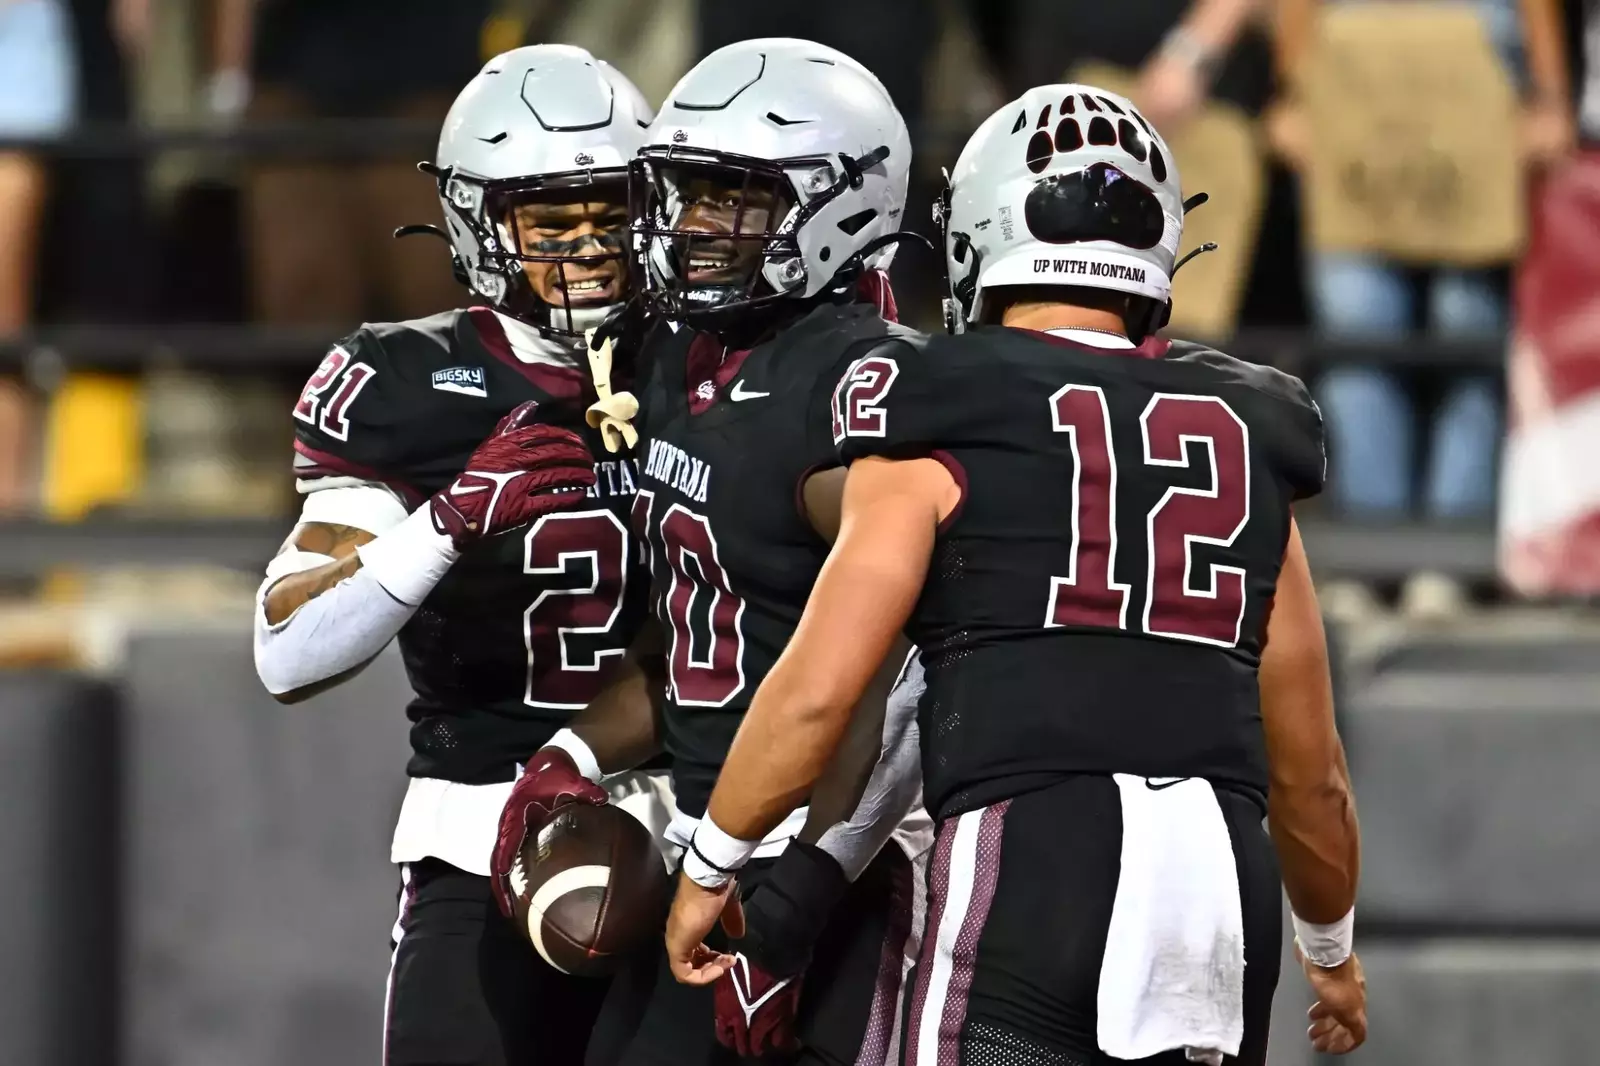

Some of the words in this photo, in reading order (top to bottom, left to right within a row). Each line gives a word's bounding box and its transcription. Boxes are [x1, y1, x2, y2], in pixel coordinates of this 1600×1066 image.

[1033, 259, 1050, 273] UP
[1052, 259, 1088, 275] WITH
[1089, 261, 1146, 283] MONTANA
[292, 343, 377, 442] 21
[831, 356, 900, 446] 12
[644, 437, 711, 503] MONTANA
[1044, 383, 1251, 649] 12
